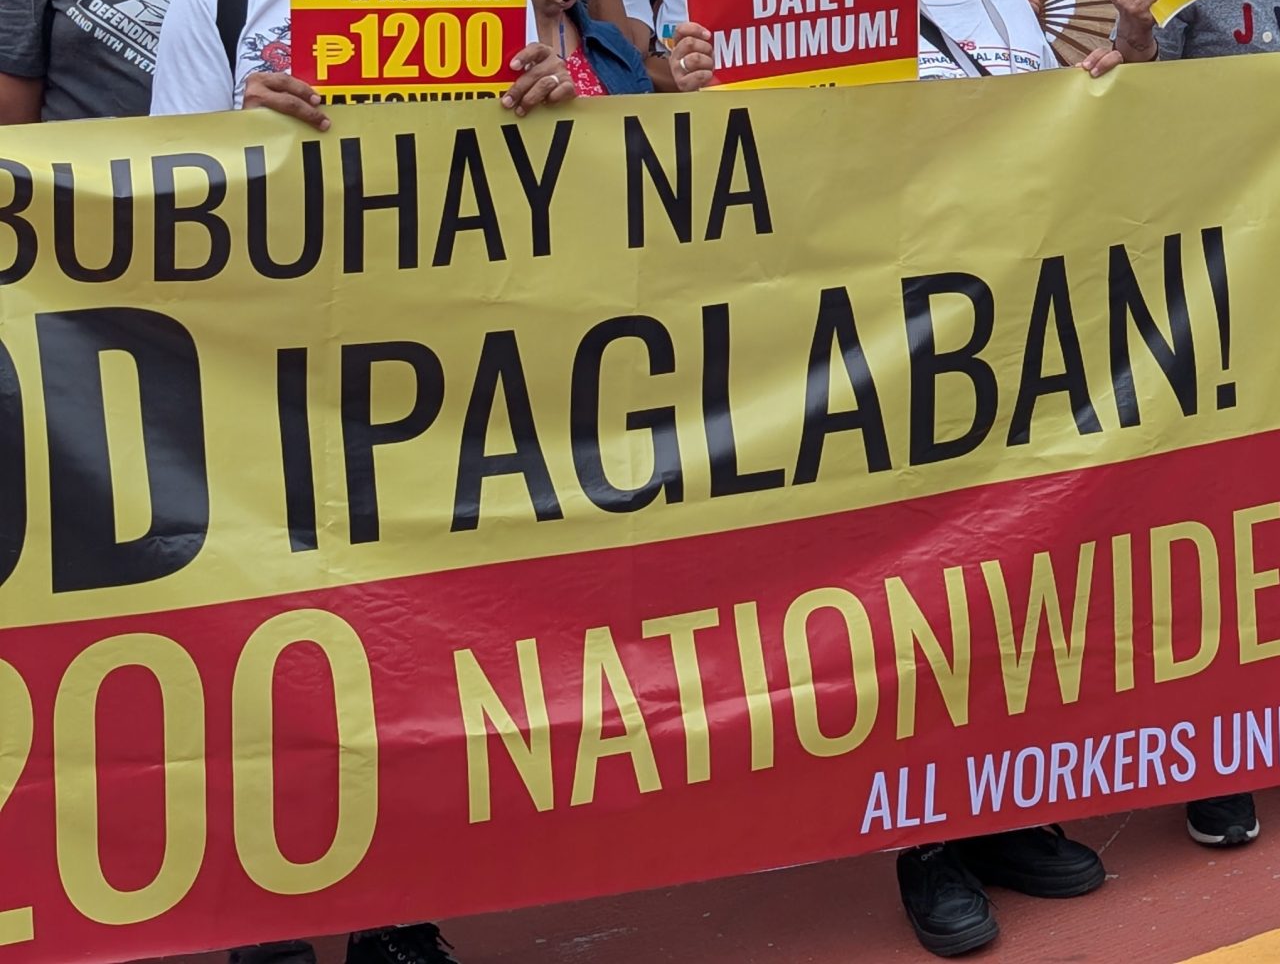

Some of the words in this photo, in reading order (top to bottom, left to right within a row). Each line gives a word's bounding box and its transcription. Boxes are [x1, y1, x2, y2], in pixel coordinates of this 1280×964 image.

[66, 6, 93, 33] STAND
[93, 26, 121, 53] WITH
[713, 9, 900, 70] MINIMUM!
[625, 108, 773, 248] NA
[0, 307, 209, 594] D
[277, 226, 1237, 554] IPAGLABAN!
[860, 763, 947, 834] ALL
[967, 721, 1195, 816] WORKERS
